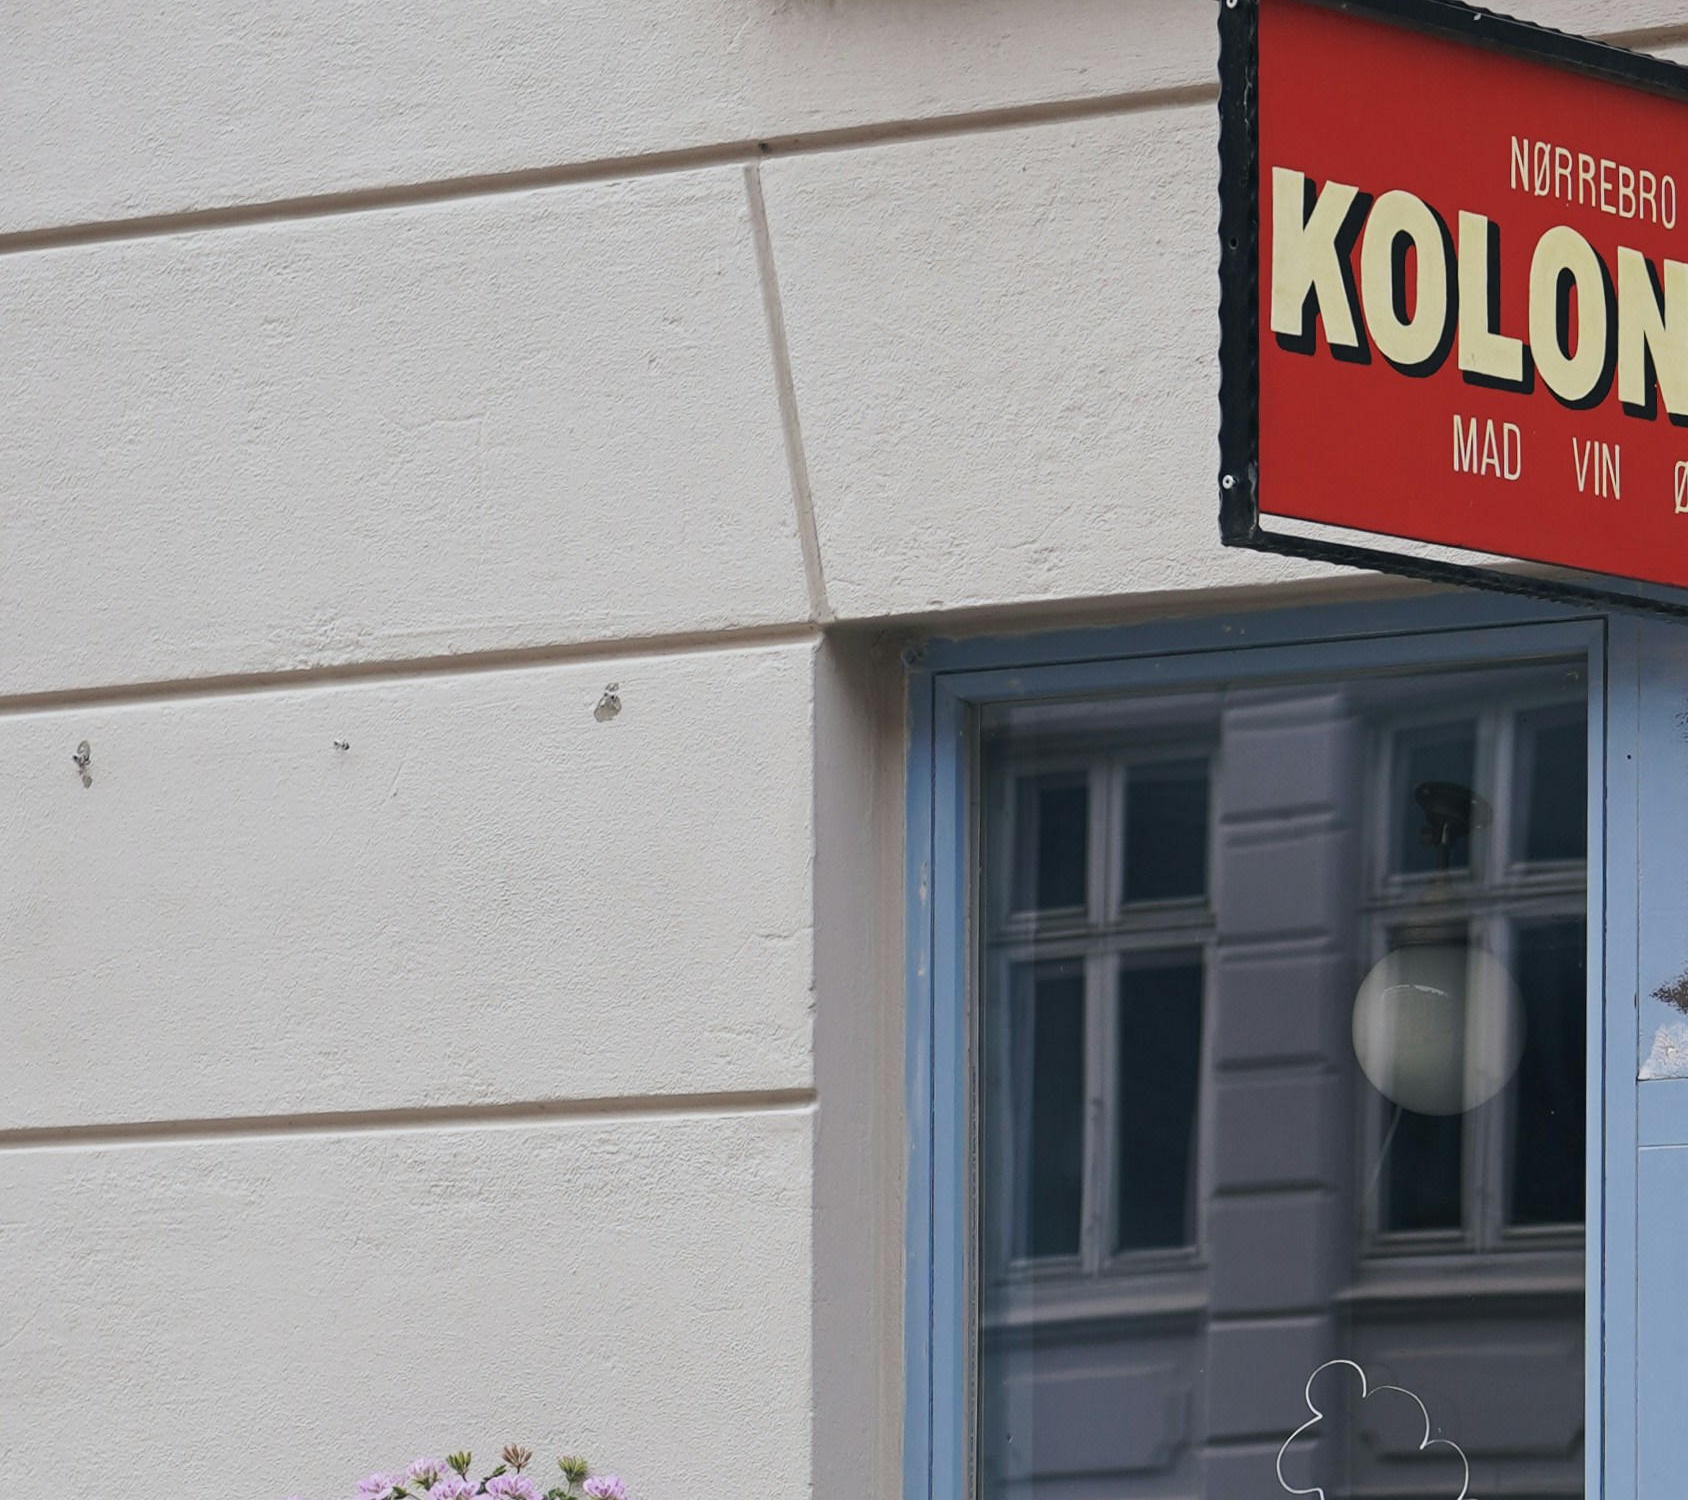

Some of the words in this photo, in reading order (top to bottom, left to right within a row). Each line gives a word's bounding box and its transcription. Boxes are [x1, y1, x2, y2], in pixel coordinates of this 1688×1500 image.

[1509, 135, 1678, 230] NØRREBRO
[1453, 414, 1522, 482] MAD
[1572, 439, 1622, 501] VIN
